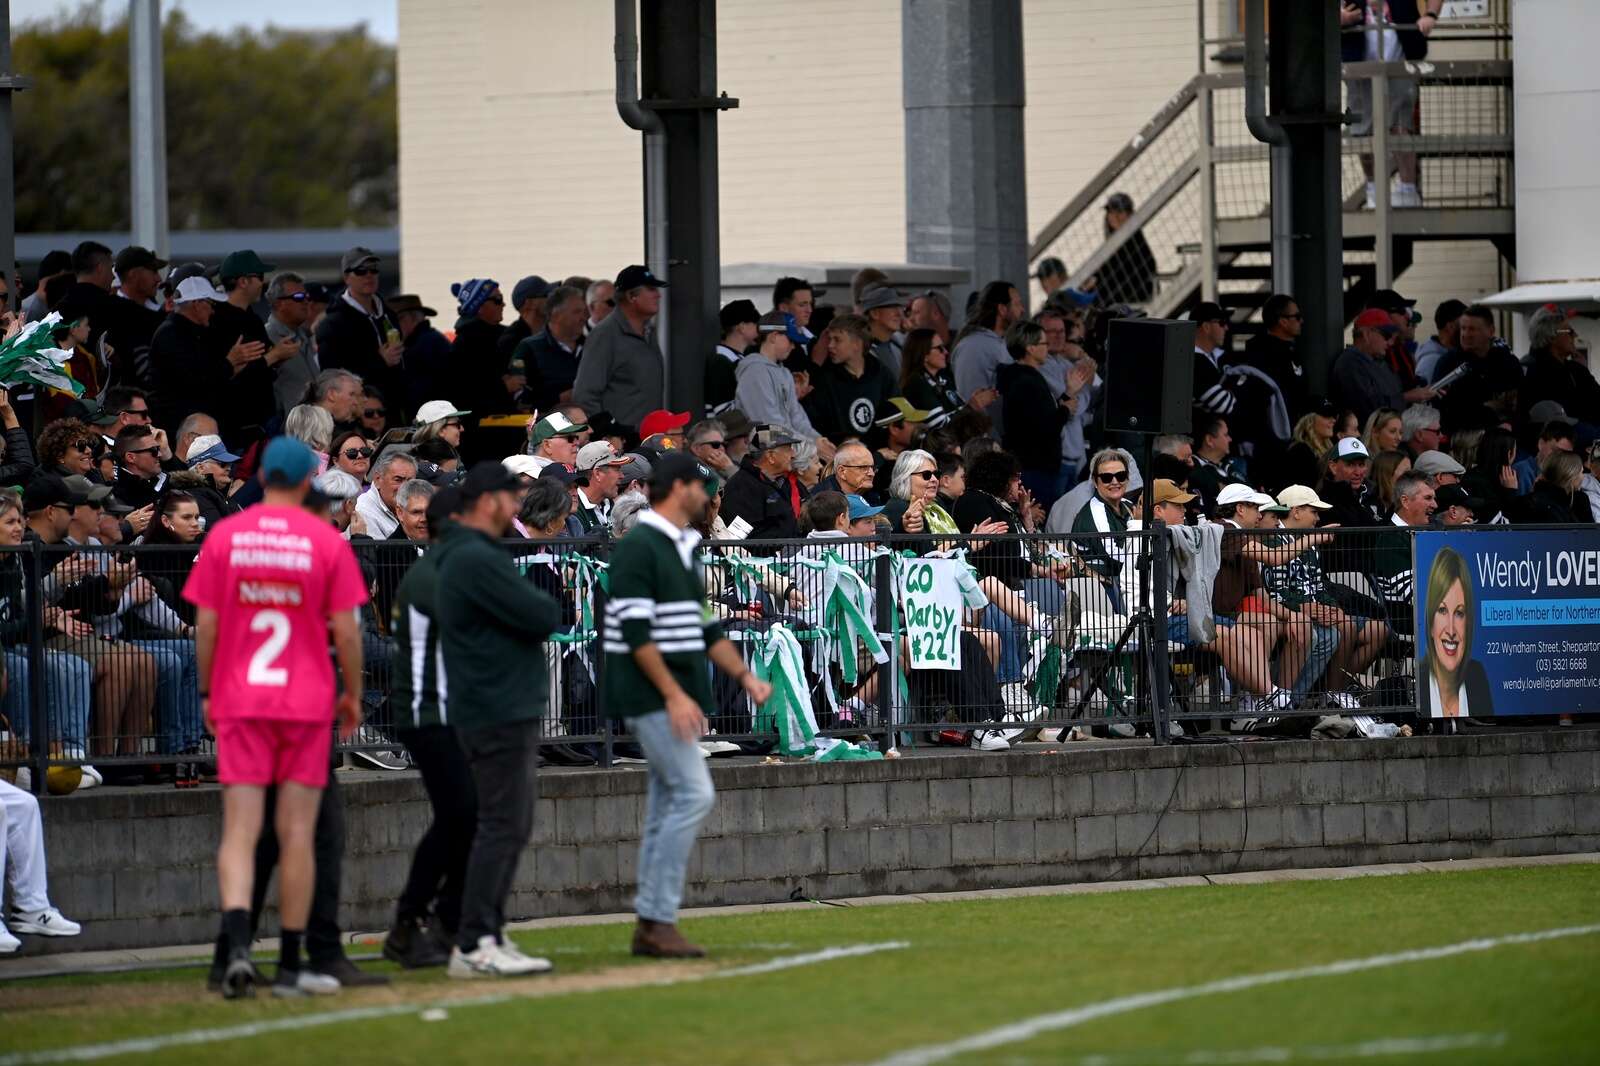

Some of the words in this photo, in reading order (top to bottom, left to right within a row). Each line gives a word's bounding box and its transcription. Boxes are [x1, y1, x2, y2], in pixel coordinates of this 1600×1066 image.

[906, 563, 933, 593] GO
[1476, 551, 1541, 594] Wendy
[239, 580, 303, 605] News
[906, 598, 955, 637] Darby
[1485, 606, 1514, 621] Liberal
[1516, 605, 1550, 620] Member
[1552, 604, 1564, 619] for
[247, 608, 291, 686] 2
[1487, 642, 1500, 654] 222
[1502, 641, 1537, 656] Wyndham
[1538, 640, 1560, 653] Street,
[1535, 658, 1551, 672] (03)
[1552, 658, 1568, 670] 5821
[1569, 657, 1588, 670] 6668
[1503, 675, 1600, 691] wendy.lovell@parliament.vic.
